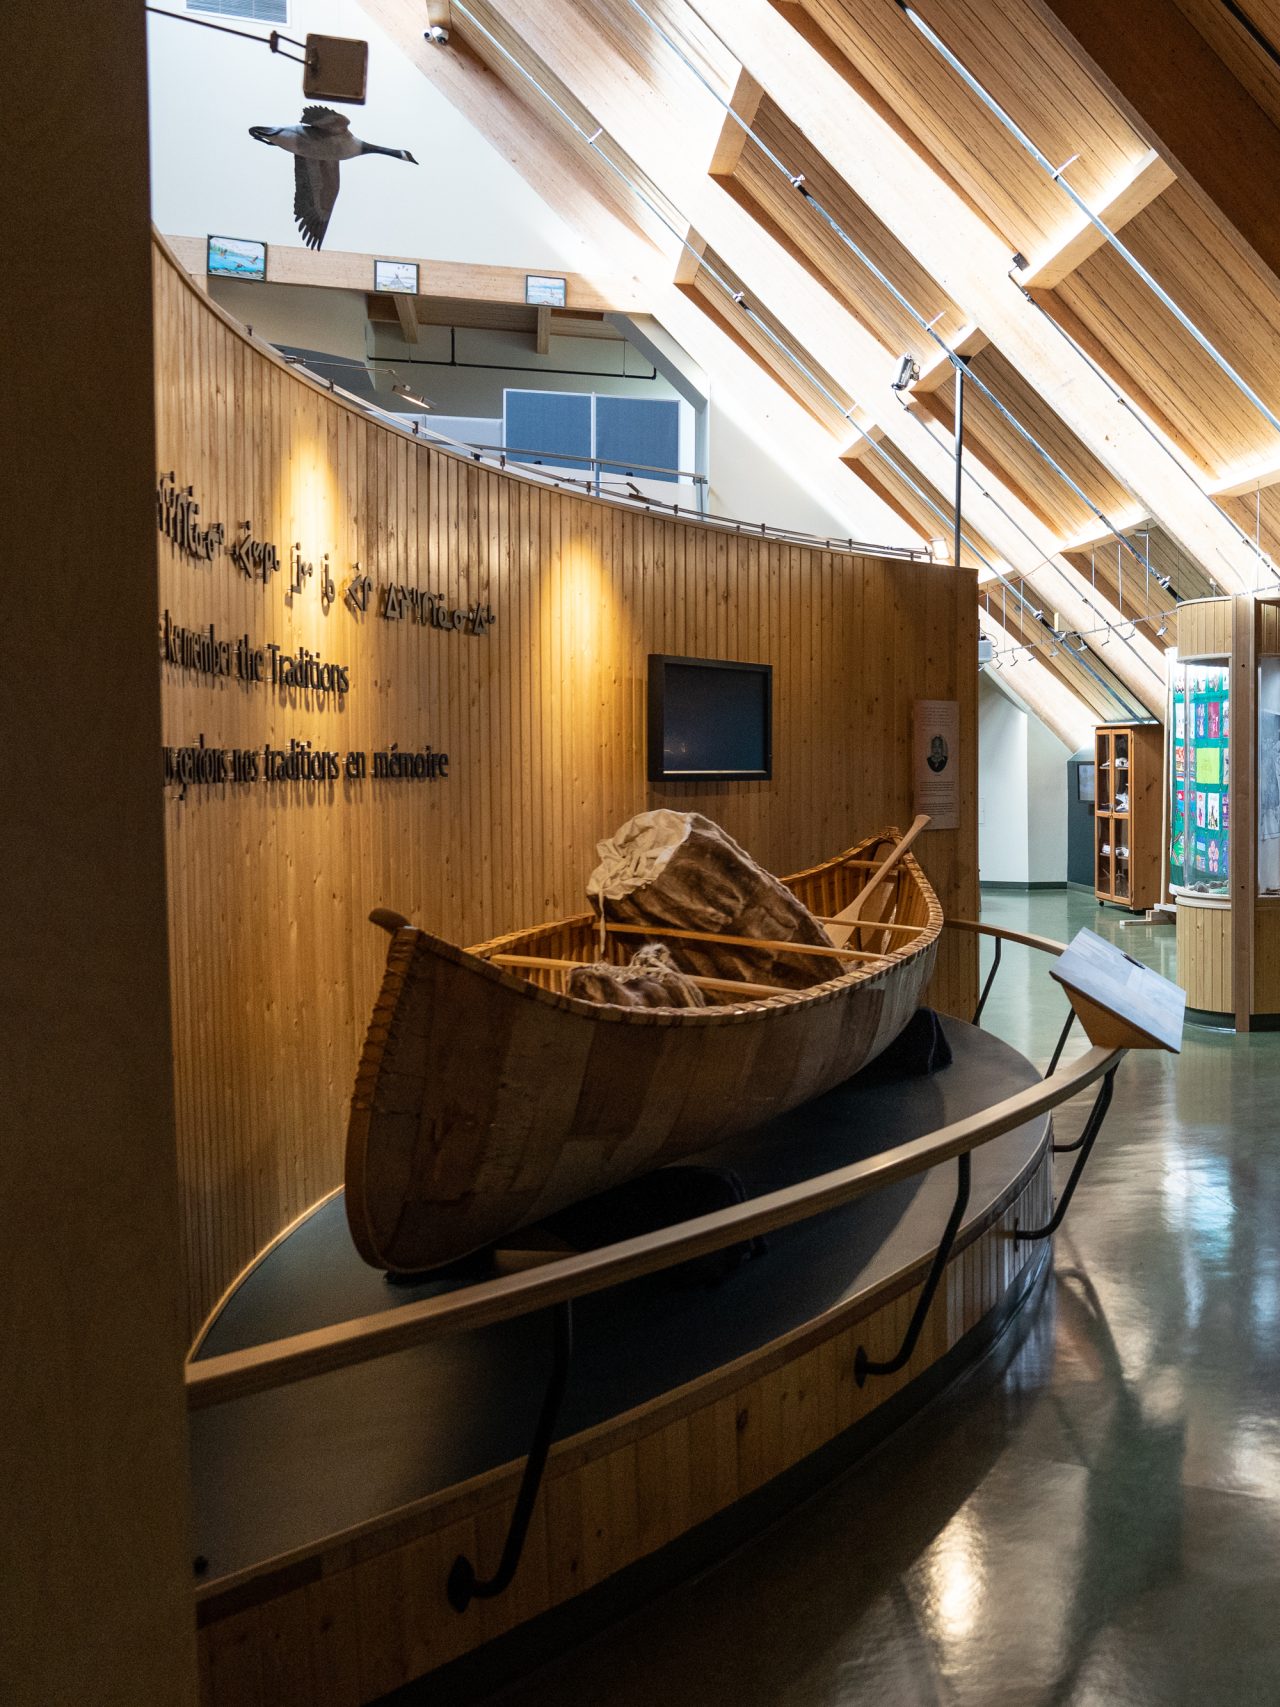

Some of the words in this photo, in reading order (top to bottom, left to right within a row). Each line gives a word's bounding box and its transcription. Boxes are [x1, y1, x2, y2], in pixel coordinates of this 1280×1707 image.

[237, 634, 264, 682] the
[267, 643, 349, 693] Traditions
[232, 748, 259, 783] nos
[264, 738, 339, 781] traditions
[346, 750, 366, 780] en
[373, 743, 449, 779] mémoire
